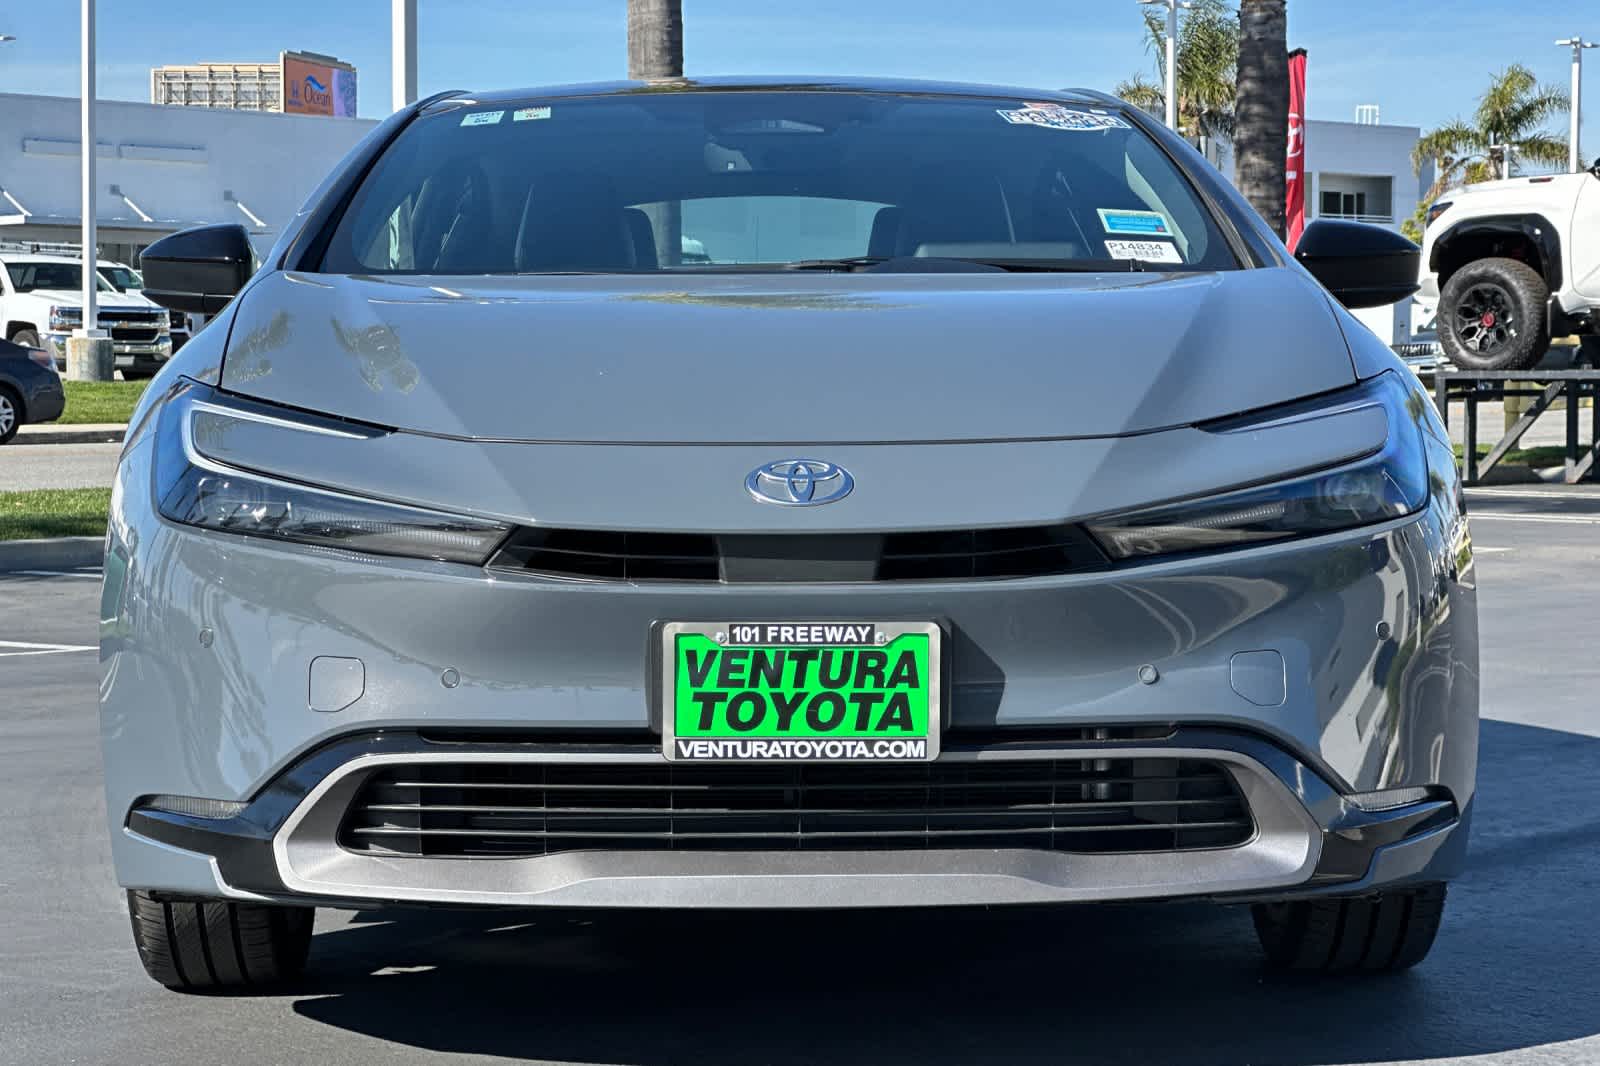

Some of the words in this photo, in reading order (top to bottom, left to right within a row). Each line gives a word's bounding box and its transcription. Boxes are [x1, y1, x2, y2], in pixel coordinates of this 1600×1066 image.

[304, 83, 331, 105] Ocean
[1108, 242, 1163, 250] P14834
[732, 626, 760, 642] 101
[767, 626, 871, 642] FREEWAY
[685, 649, 919, 689] VENTURA
[692, 691, 914, 732] TOYOTA
[679, 740, 925, 758] VENTURATOYOTA.COM
